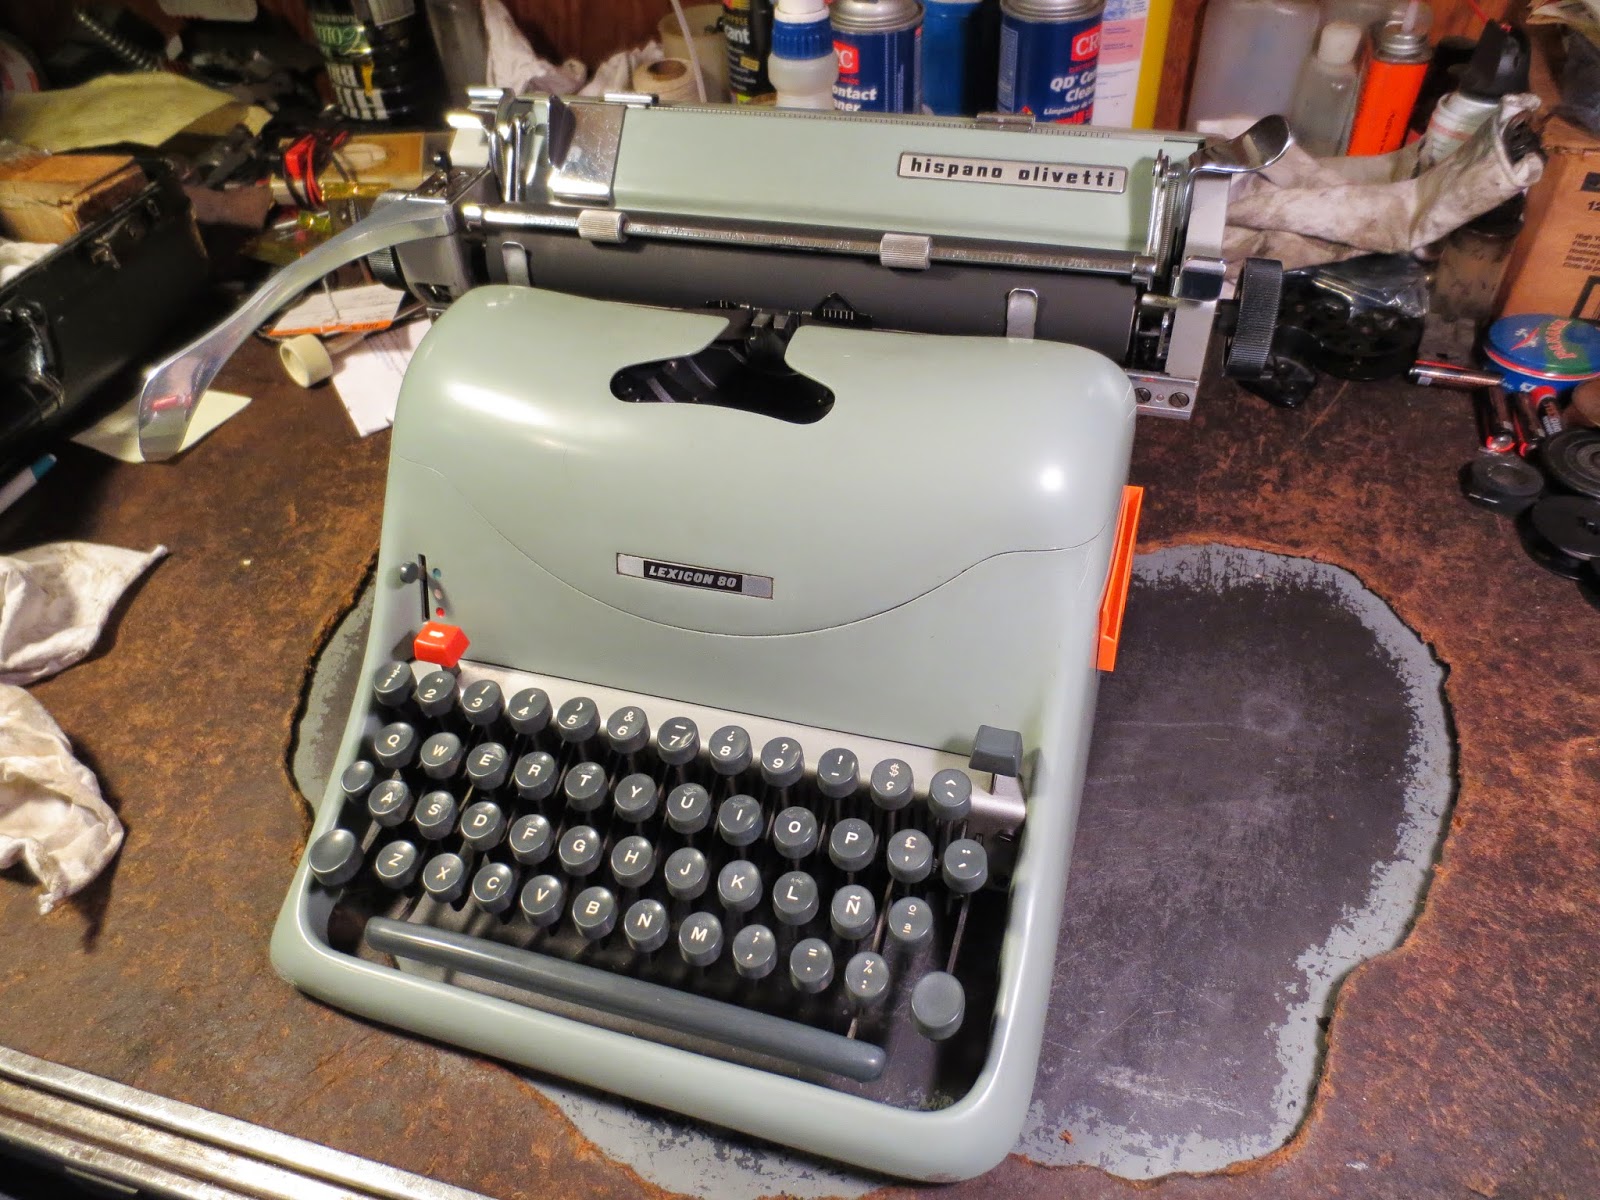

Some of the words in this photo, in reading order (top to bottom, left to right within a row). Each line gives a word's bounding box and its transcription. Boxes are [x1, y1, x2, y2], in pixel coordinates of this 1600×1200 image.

[833, 84, 878, 101] ontact
[910, 157, 1003, 179] hispano
[1018, 166, 1114, 188] olivetti
[649, 565, 714, 585] LEXICON
[717, 576, 737, 588] 80
[424, 689, 437, 699] 2
[471, 697, 482, 708] 3
[518, 705, 529, 717] 4
[623, 711, 635, 723] &
[566, 715, 579, 725] 5
[617, 725, 628, 736] 6
[387, 733, 401, 748] Q
[670, 735, 681, 747] 7
[433, 744, 449, 757] W
[719, 745, 731, 756] 8
[781, 743, 789, 754] ?
[478, 754, 492, 766] E
[772, 758, 784, 769] 9
[528, 764, 542, 777] R
[888, 763, 900, 777] $
[580, 774, 593, 787] T
[380, 791, 394, 803] A
[630, 785, 643, 799] Y
[428, 803, 442, 816] S
[681, 797, 694, 809] U
[473, 814, 488, 827] D
[736, 809, 744, 821] I
[522, 827, 537, 841] F
[788, 821, 801, 834] O
[844, 832, 860, 845] P
[904, 836, 917, 849] £
[572, 840, 586, 853] G
[387, 853, 403, 867] Z
[624, 850, 640, 864] H
[435, 866, 451, 881] X
[679, 863, 692, 876] J
[486, 876, 501, 890] C
[730, 874, 745, 889] K
[536, 887, 550, 902] V
[786, 887, 799, 901] L
[585, 900, 600, 915] B
[845, 894, 862, 916] Ñ
[636, 913, 654, 928] N
[690, 925, 709, 943] M
